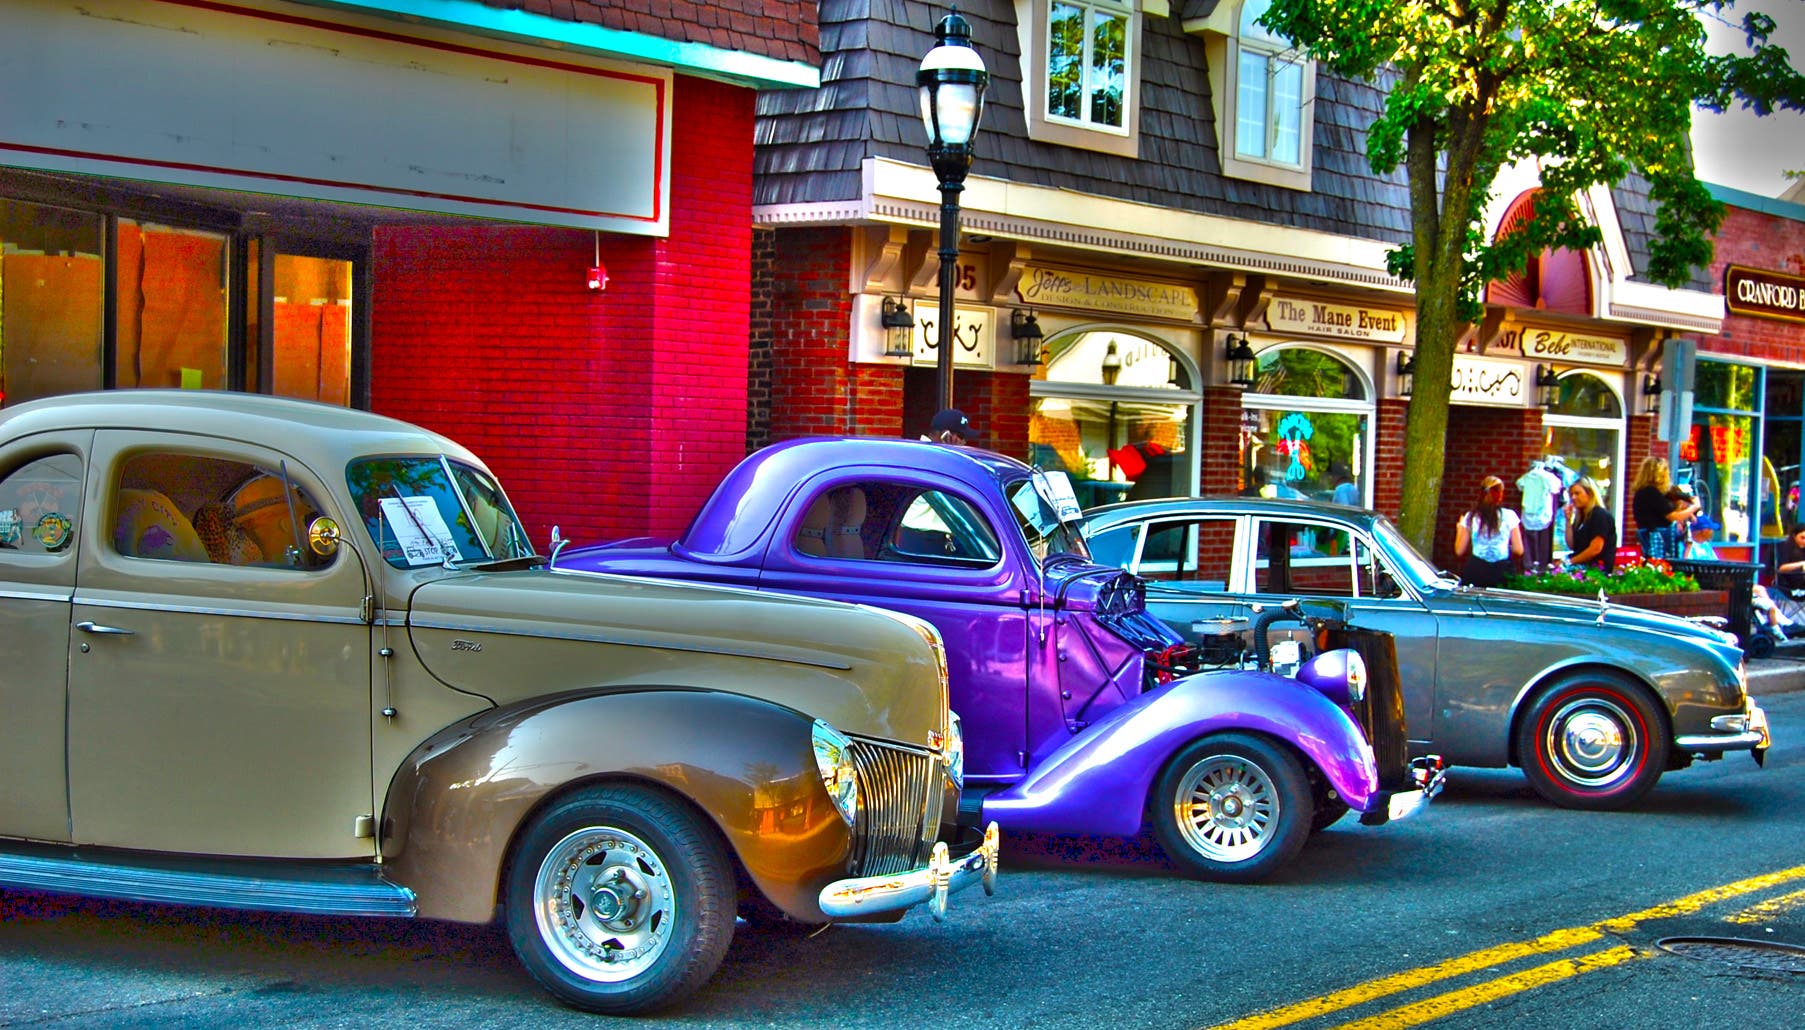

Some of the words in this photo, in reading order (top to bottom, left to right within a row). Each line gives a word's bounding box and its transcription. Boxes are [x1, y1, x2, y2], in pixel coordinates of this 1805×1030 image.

[1737, 279, 1797, 309] CRANFORD
[1278, 301, 1306, 322] The
[1312, 304, 1353, 327] Mane
[1358, 310, 1398, 332] Event
[1336, 329, 1370, 338] SALON
[1534, 331, 1570, 355] Bebe
[1570, 338, 1617, 353] INTERNATIONAL
